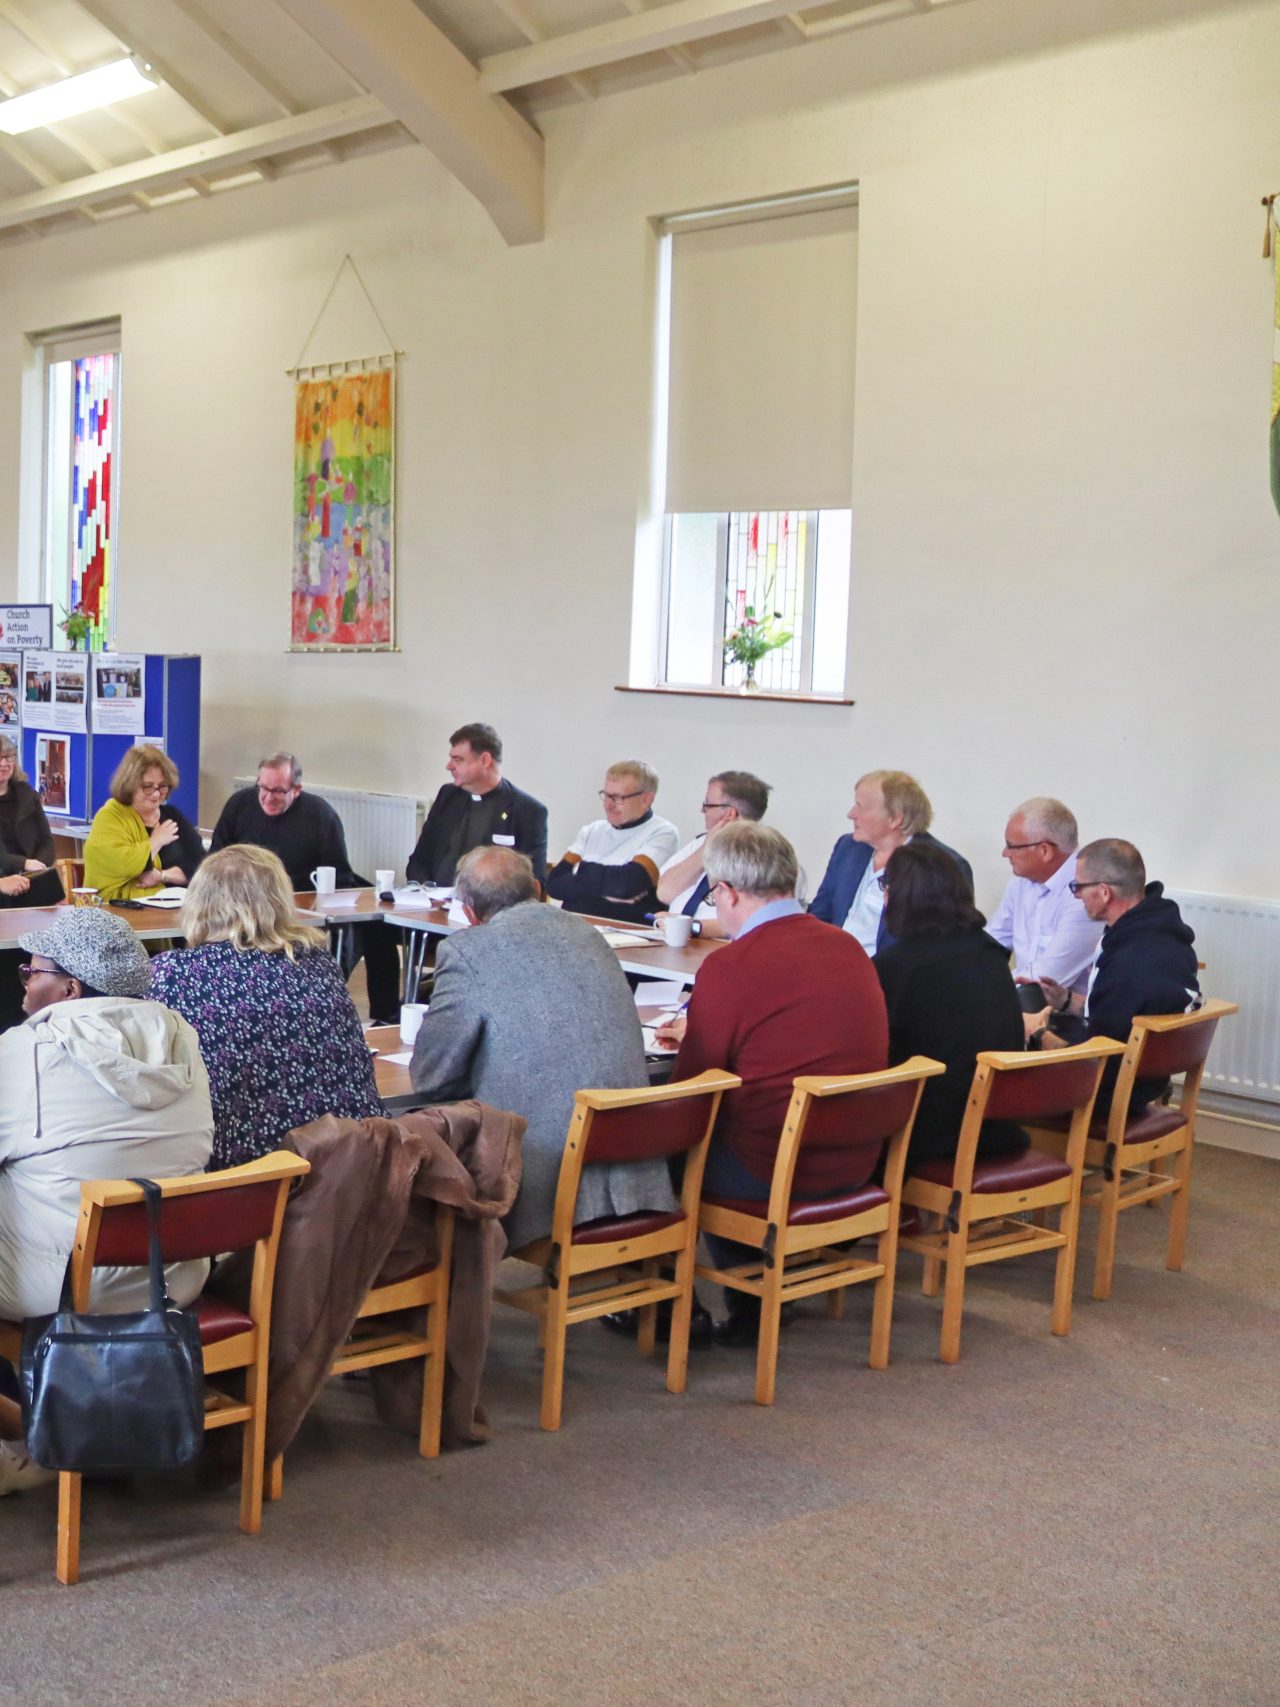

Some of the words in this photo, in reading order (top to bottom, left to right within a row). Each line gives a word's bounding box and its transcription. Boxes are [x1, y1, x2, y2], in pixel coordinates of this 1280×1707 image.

[7, 609, 30, 619] Church
[7, 623, 29, 631] Action
[17, 635, 43, 647] Poverty
